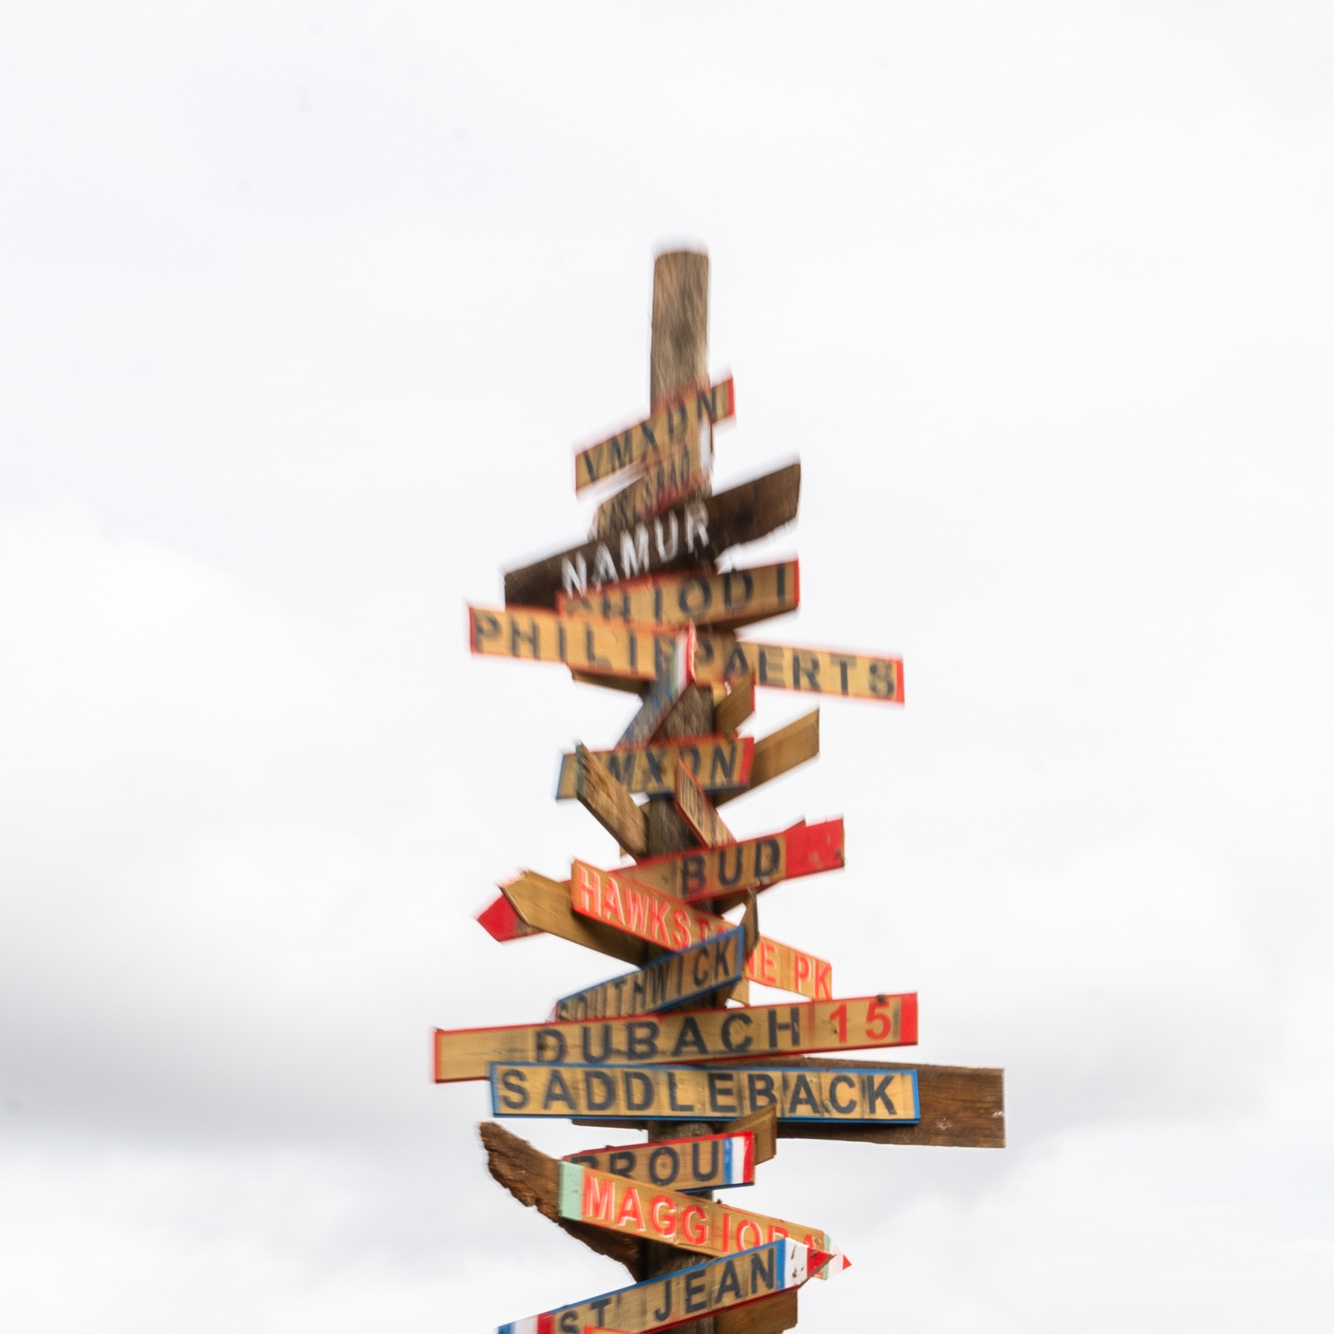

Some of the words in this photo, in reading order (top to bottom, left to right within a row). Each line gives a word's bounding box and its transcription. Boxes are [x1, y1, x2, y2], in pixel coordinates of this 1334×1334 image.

[562, 500, 710, 598] NAMUR
[681, 838, 782, 897] BUD
[579, 867, 778, 986] HAWKSTE
[794, 953, 832, 1000] PK
[536, 1006, 801, 1063] DUBACH
[828, 1001, 893, 1044] 15
[500, 1069, 897, 1115] SADDLEBACK
[654, 1247, 776, 1323] JEAN
